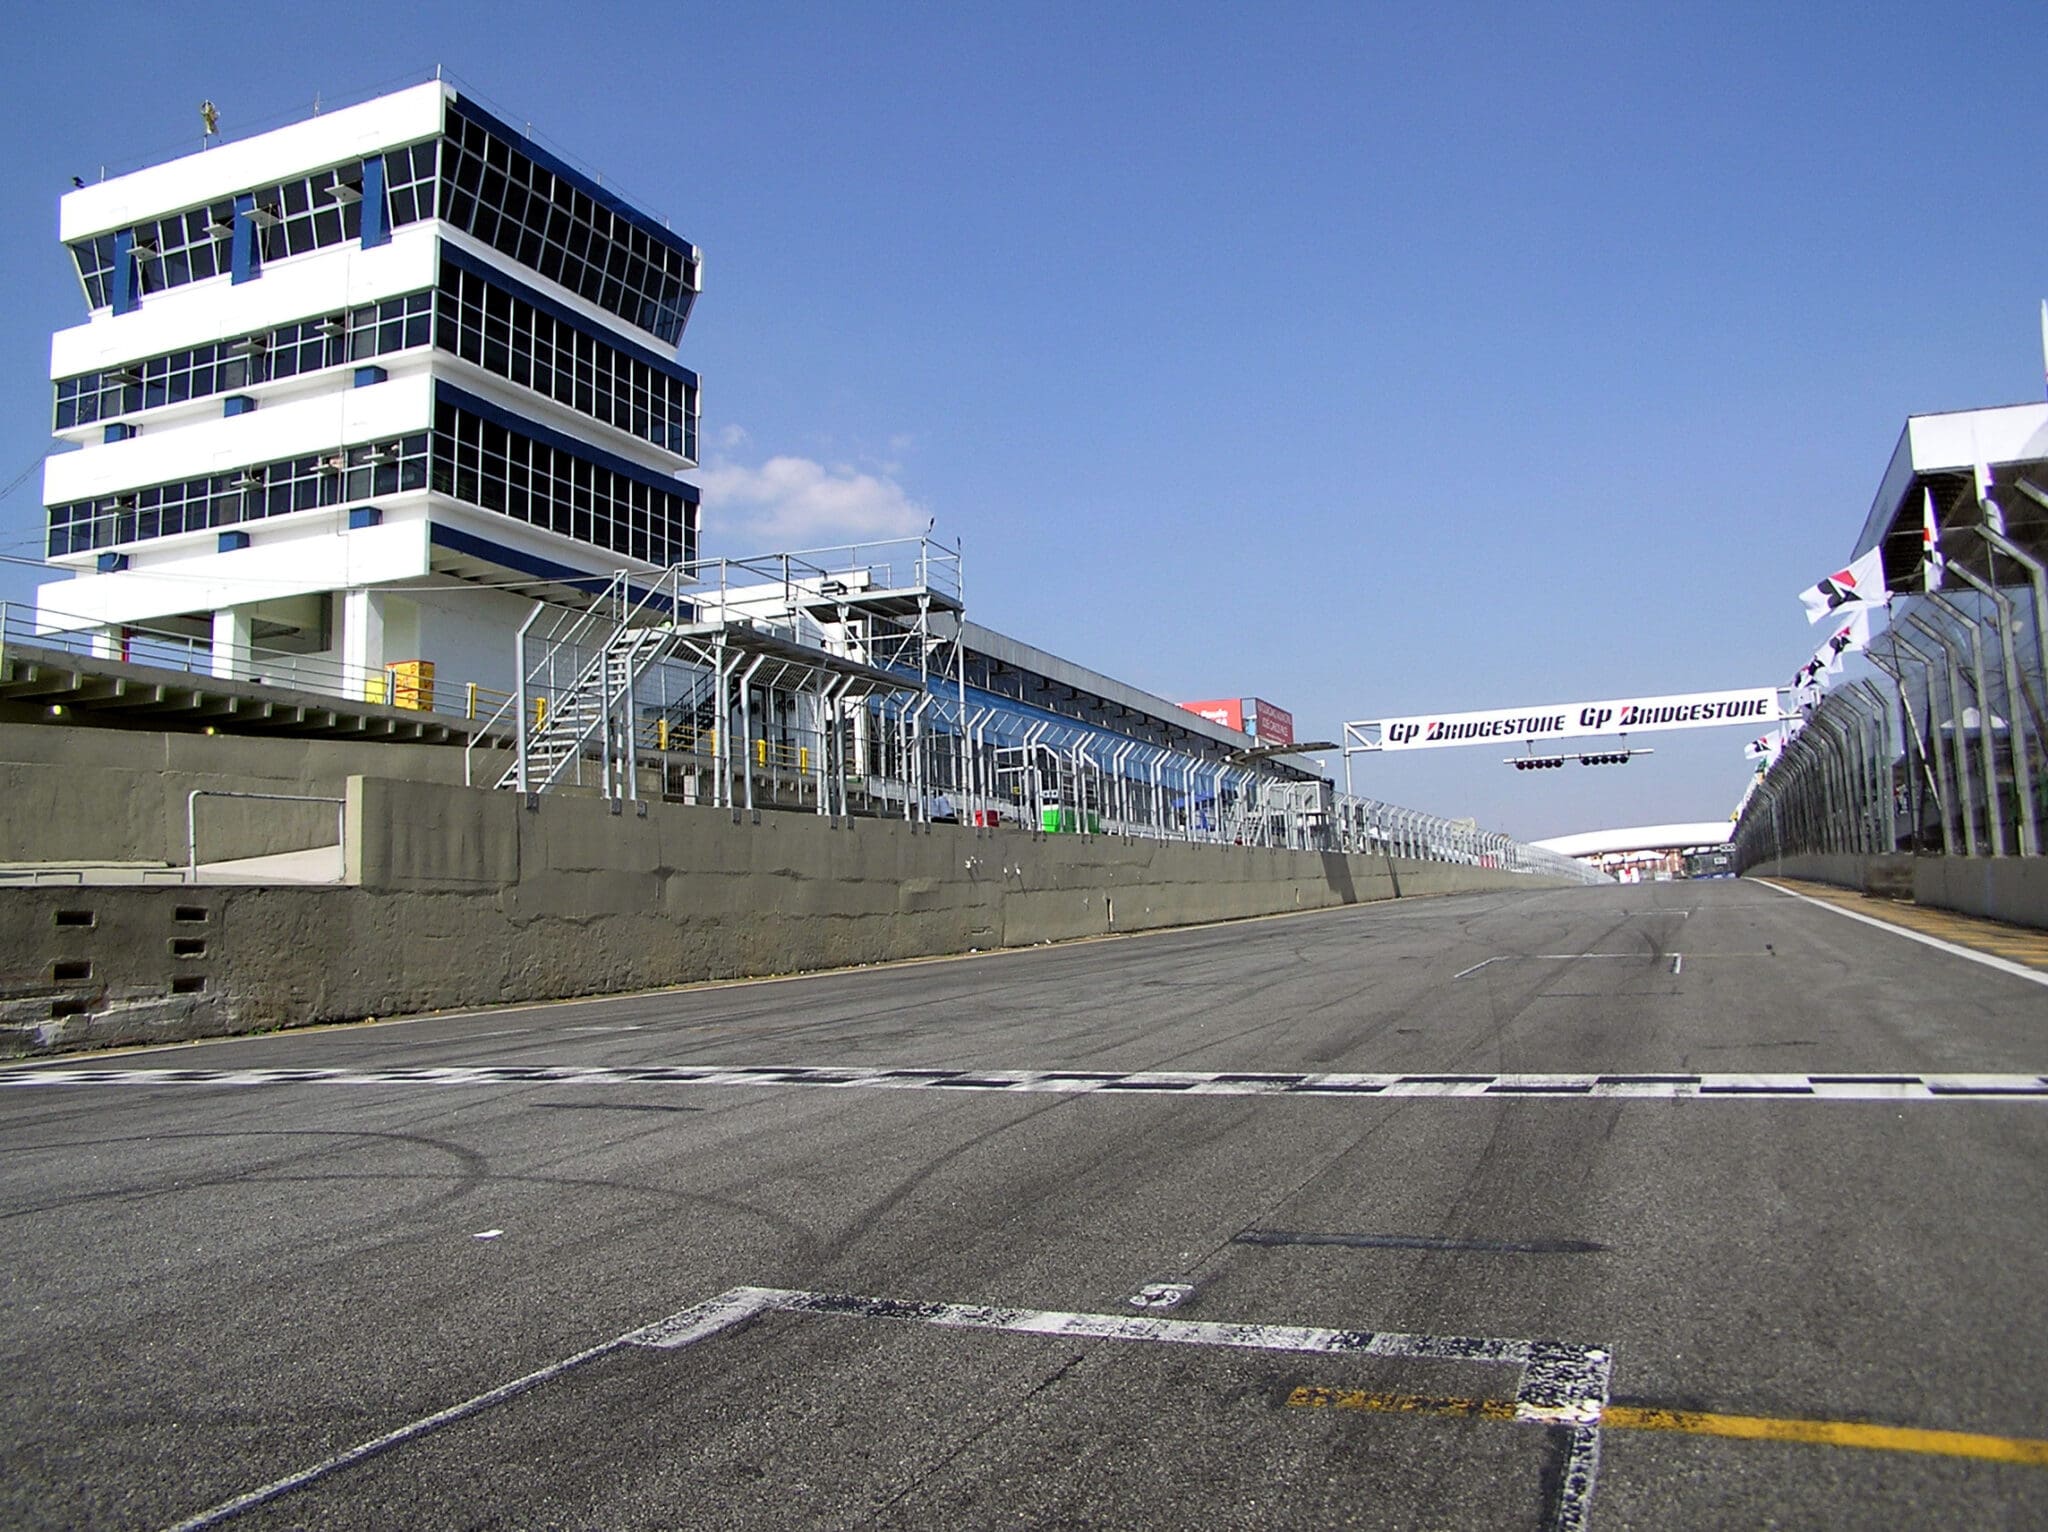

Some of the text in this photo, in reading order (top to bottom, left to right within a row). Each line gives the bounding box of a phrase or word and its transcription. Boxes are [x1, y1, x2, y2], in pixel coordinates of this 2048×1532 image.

[1389, 699, 1768, 744] GP BRIDGESTONE GP BRIDGESTONE
